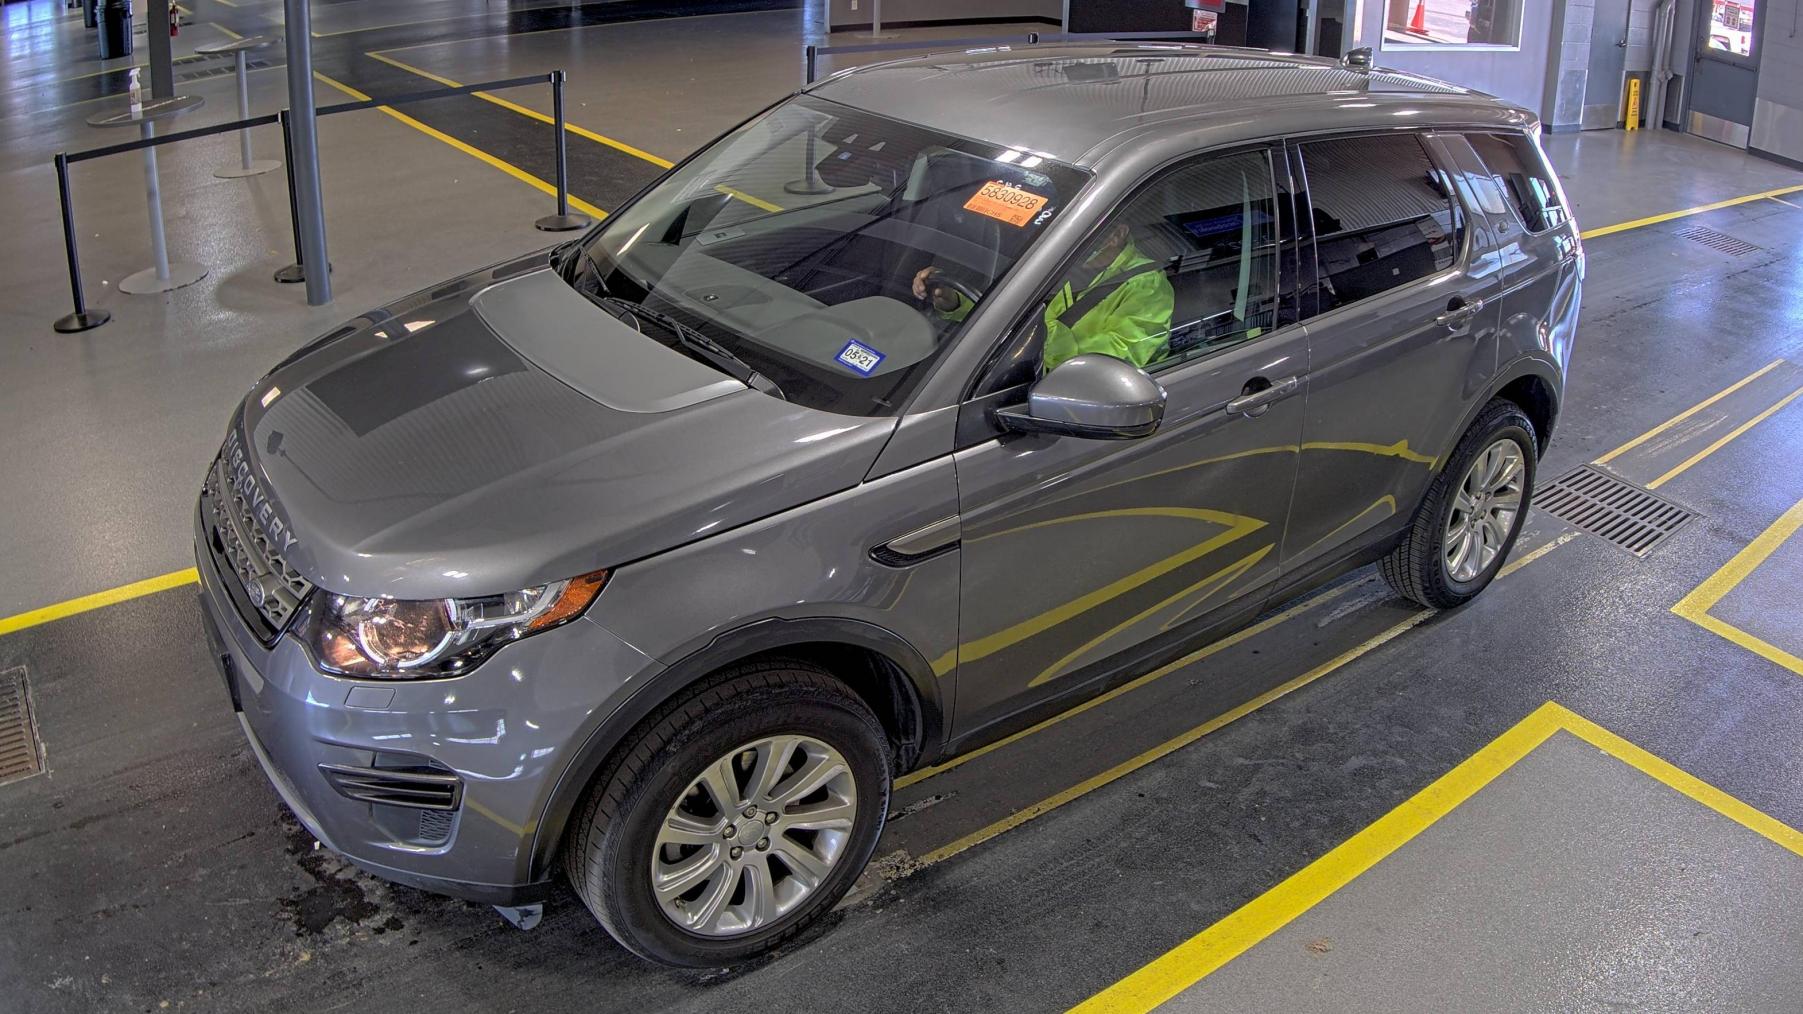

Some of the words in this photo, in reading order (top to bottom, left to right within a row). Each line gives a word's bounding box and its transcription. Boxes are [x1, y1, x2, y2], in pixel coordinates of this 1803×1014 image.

[981, 185, 1038, 209] 5830928
[845, 348, 860, 360] 05
[859, 356, 874, 367] 21
[227, 428, 299, 552] DISCOVERY
